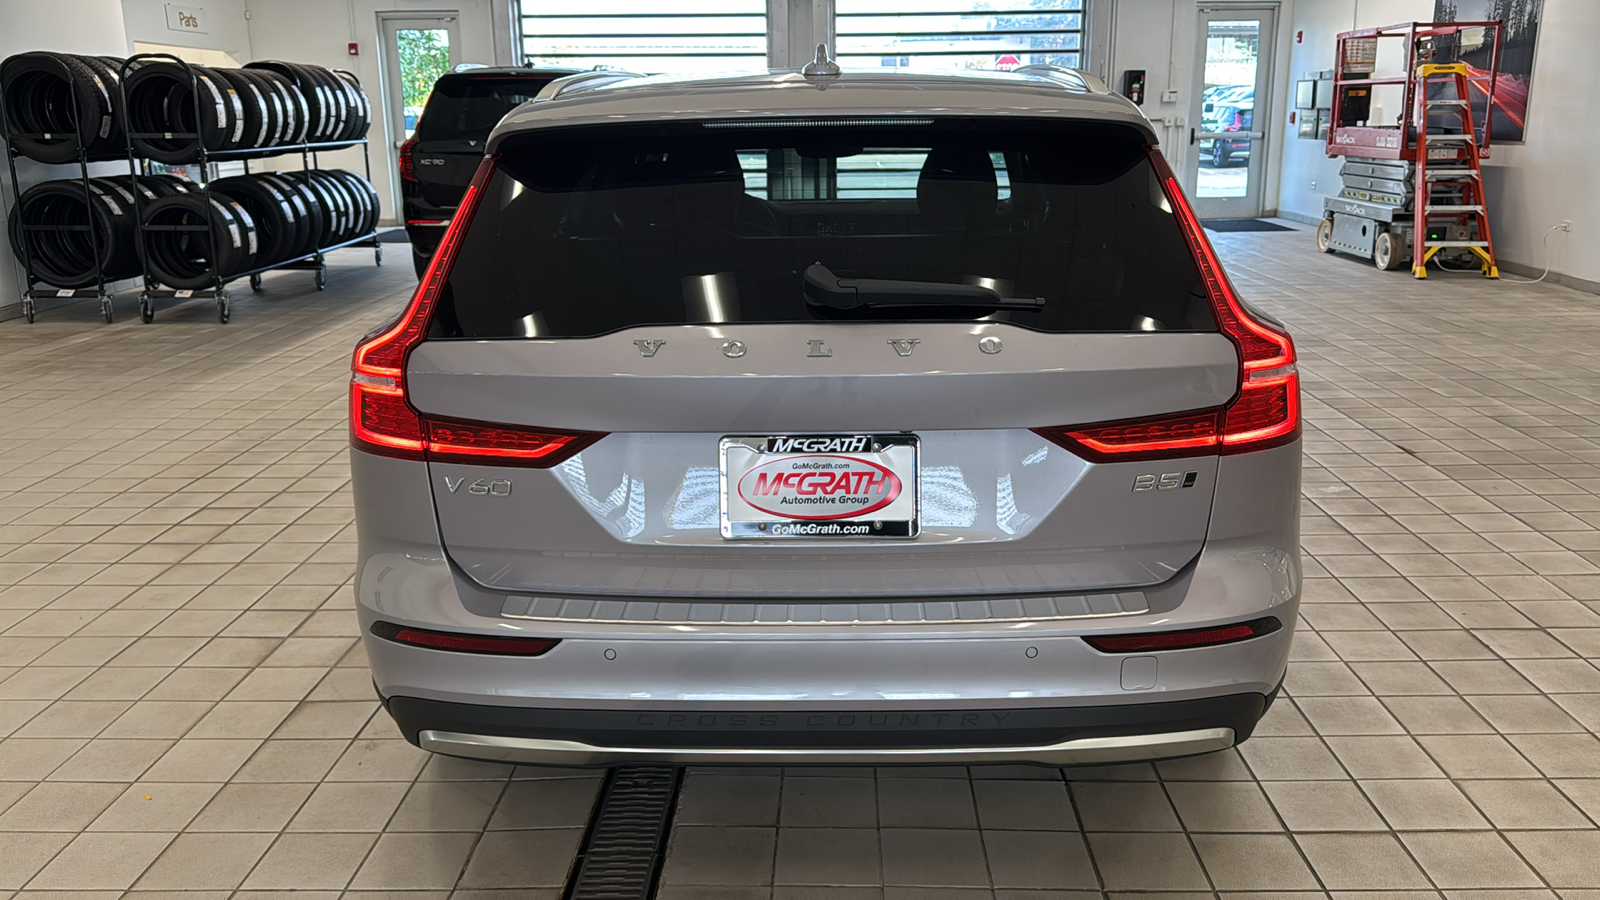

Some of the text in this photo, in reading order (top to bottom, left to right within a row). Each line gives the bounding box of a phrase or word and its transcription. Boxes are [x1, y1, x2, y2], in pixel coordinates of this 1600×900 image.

[178, 11, 198, 28] Parts
[633, 336, 1004, 358] VOLVO
[791, 462, 850, 470] GoMcGrath.com
[1131, 473, 1181, 493] B5
[780, 495, 870, 506] Automotive Group
[771, 523, 870, 535] GoMcGrath.com
[636, 711, 1011, 727] CROSS COUNTRY
